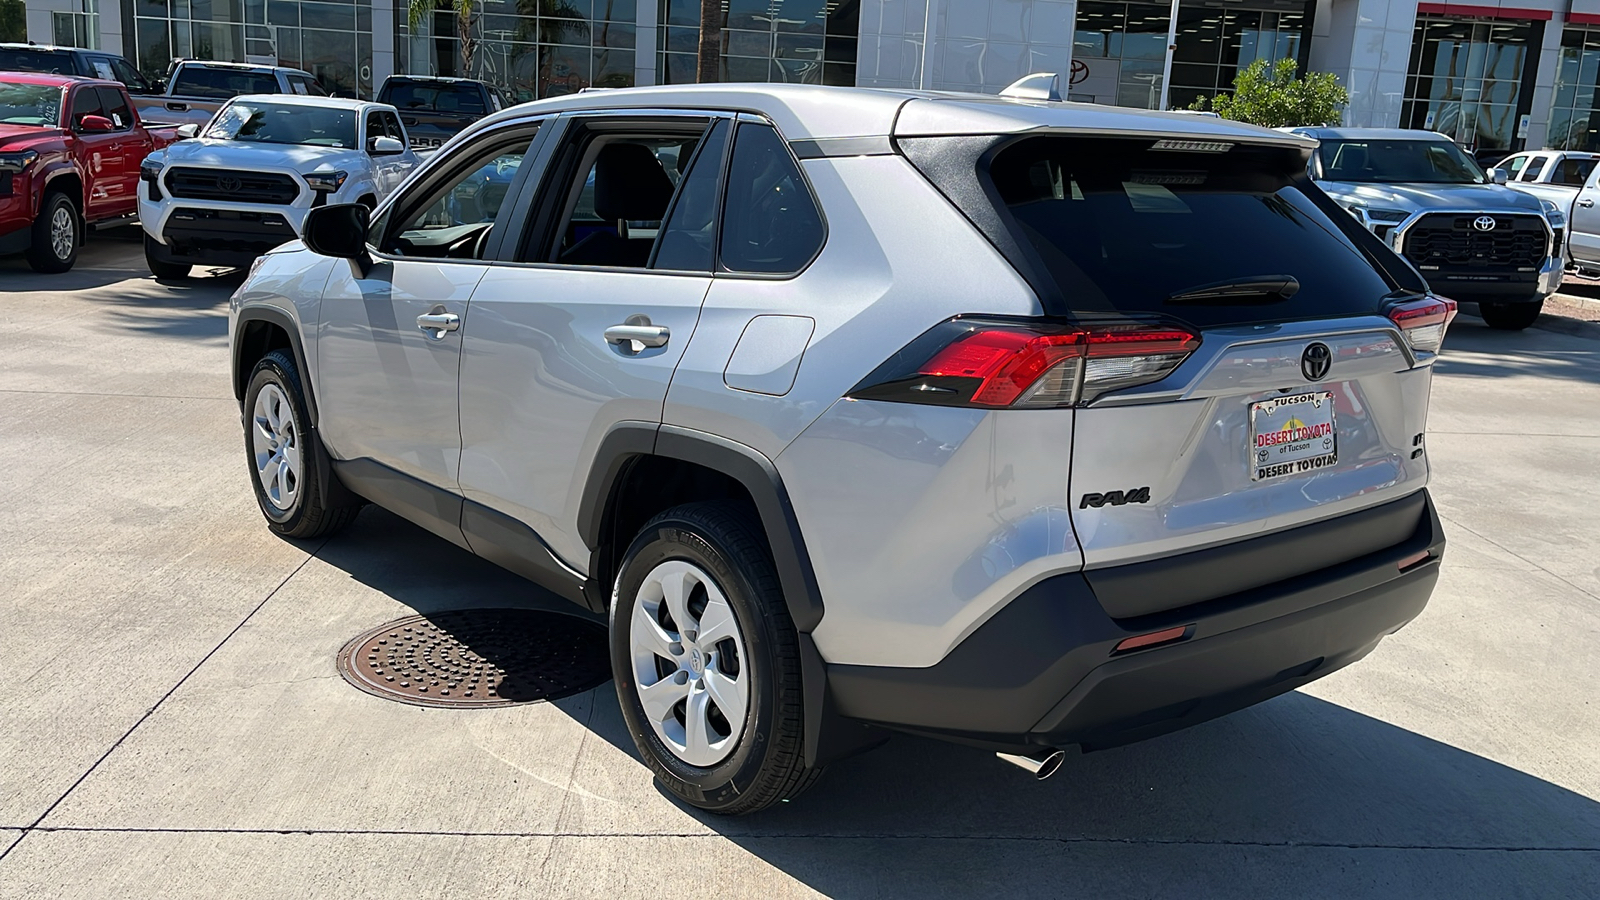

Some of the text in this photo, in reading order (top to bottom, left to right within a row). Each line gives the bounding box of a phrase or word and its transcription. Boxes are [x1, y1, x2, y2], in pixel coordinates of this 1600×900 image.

[1274, 394, 1315, 407] TUCSON
[1257, 422, 1332, 447] DESERT TOYOTA
[1279, 442, 1311, 454] of Tucson
[1258, 462, 1294, 479] DESERT
[1079, 486, 1151, 509] RAV4
[680, 531, 726, 578] MICHELIN
[640, 744, 682, 792] MICHELIN
